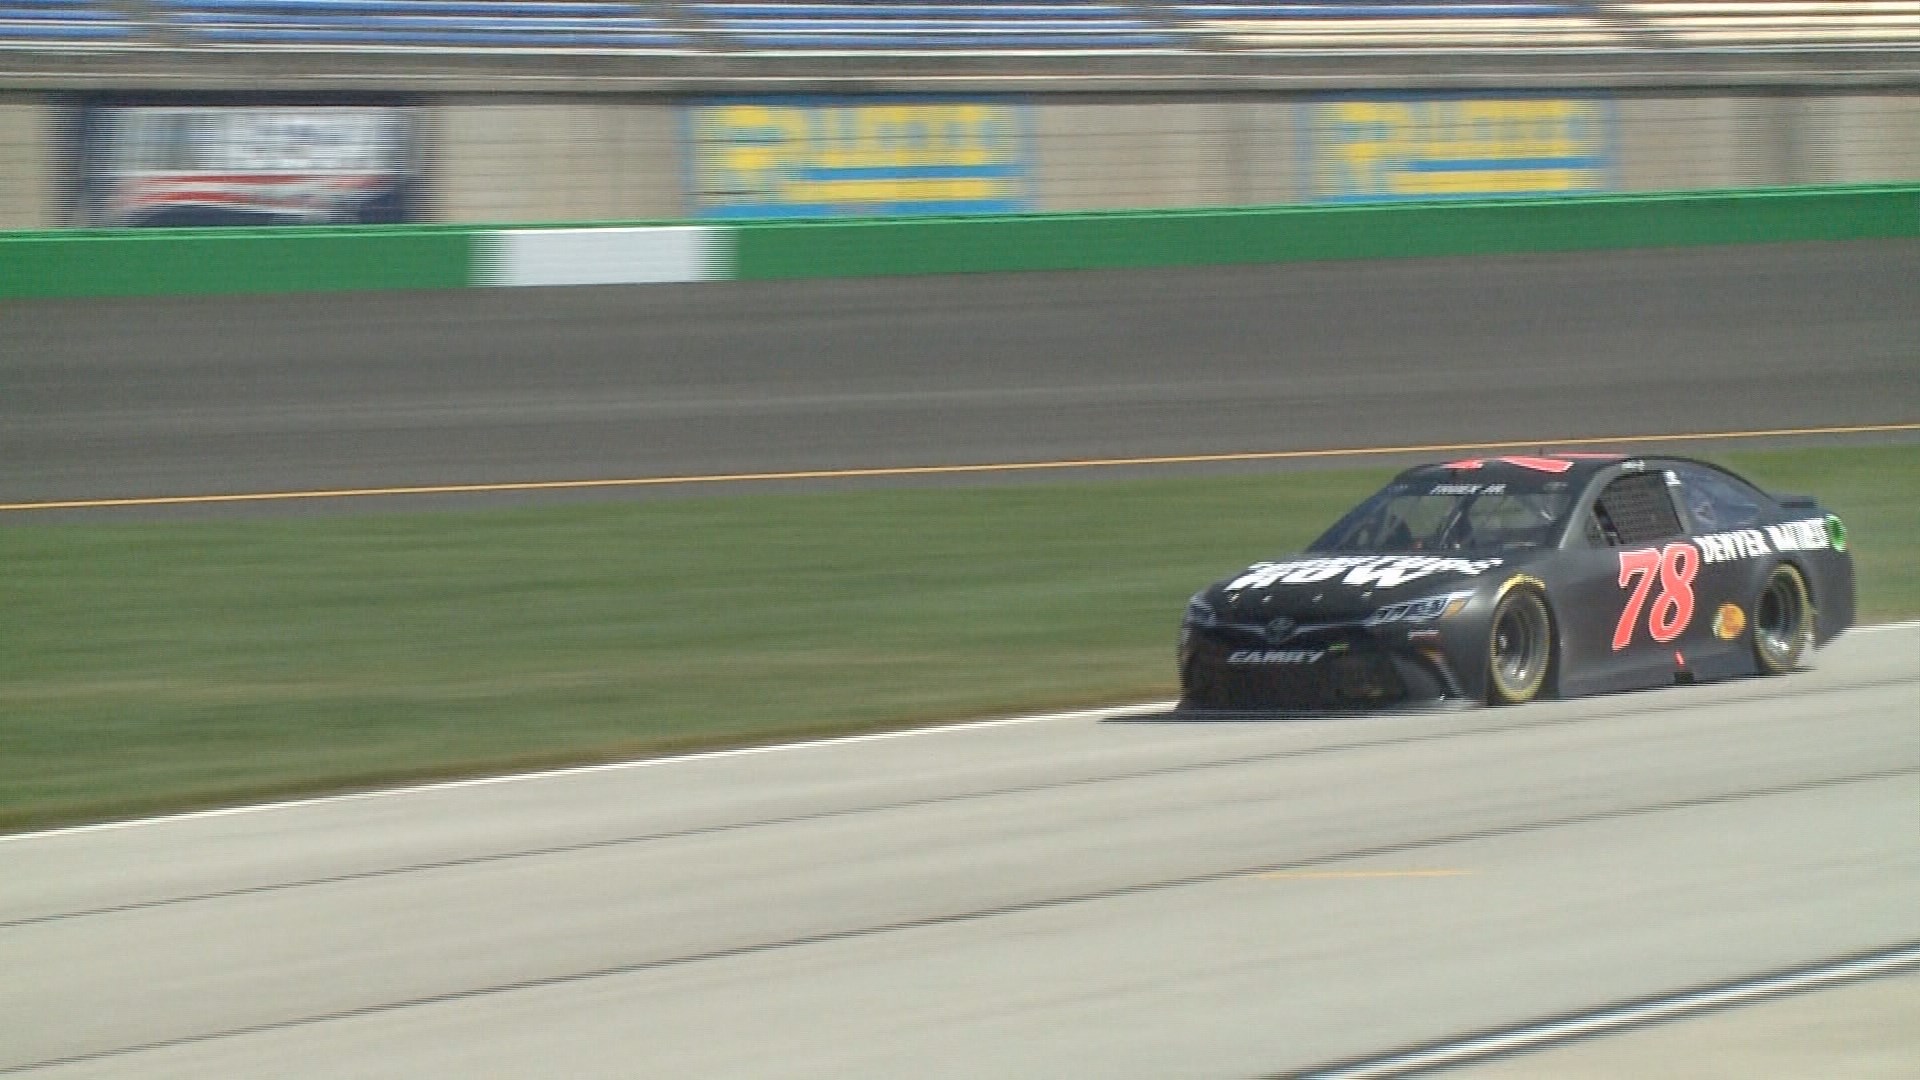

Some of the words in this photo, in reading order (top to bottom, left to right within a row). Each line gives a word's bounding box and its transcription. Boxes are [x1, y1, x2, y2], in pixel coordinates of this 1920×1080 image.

[1692, 528, 1773, 564] DENVER
[1611, 540, 1700, 652] 78
[1227, 649, 1326, 665] CAMRY
